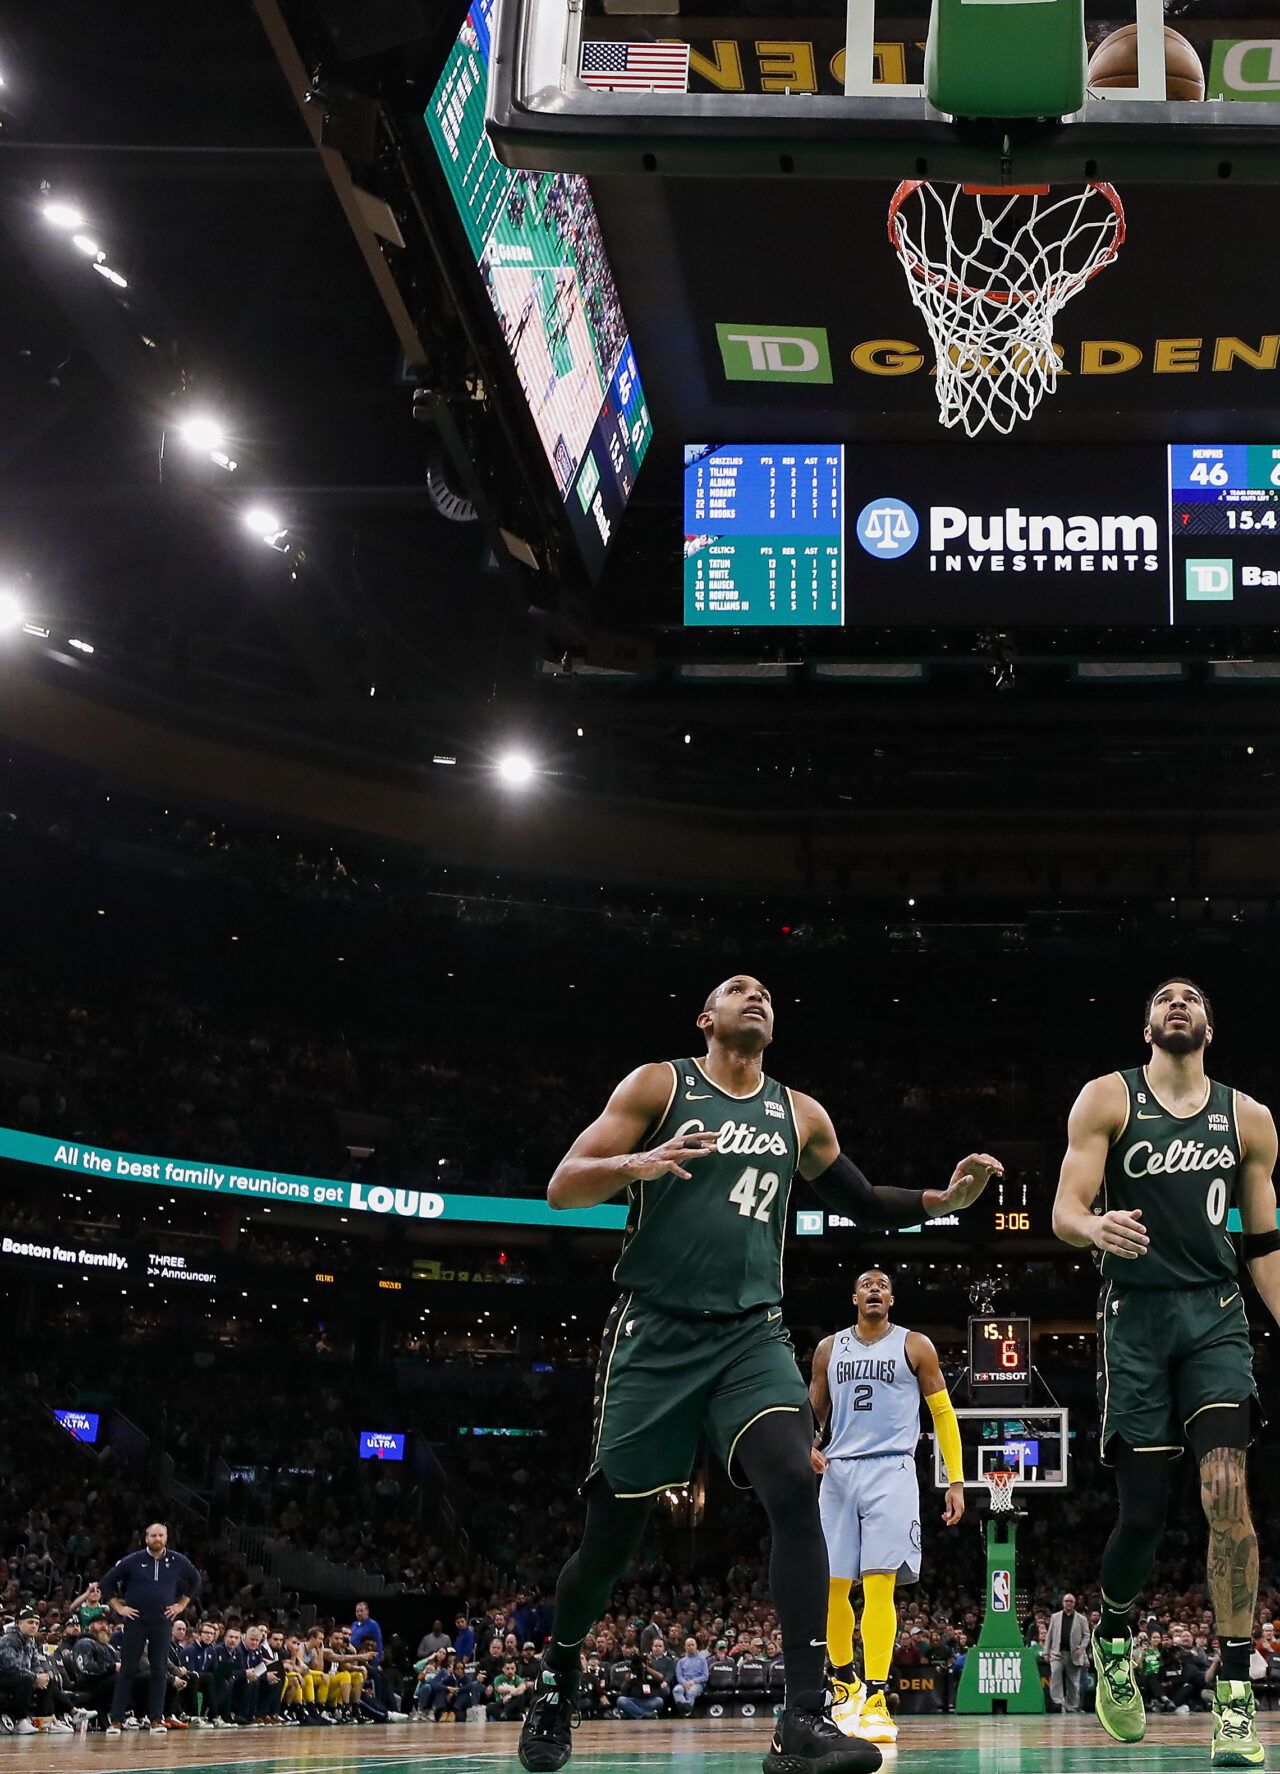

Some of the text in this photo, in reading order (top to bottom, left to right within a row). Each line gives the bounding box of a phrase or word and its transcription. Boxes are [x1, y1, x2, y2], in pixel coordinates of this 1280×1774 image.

[728, 335, 820, 372] TD
[709, 457, 743, 465] GRIZZLIES
[1193, 449, 1223, 458] MEMPHIS
[1190, 463, 1228, 485] 46
[697, 489, 704, 498] 12
[696, 499, 705, 508] 22
[1227, 511, 1276, 529] 15.4
[930, 507, 1157, 551] Putnam
[709, 546, 735, 554] CELTICS
[931, 555, 1158, 571] INVESTMENTS
[695, 581, 704, 590] 30
[1190, 566, 1229, 592] TD
[695, 591, 704, 600] 42
[695, 602, 704, 611] 44
[685, 1075, 695, 1087] 6
[1136, 1092, 1147, 1104] 6
[763, 1100, 785, 1113] VISTA
[765, 1108, 785, 1119] PRINT
[1207, 1114, 1229, 1125] VISTA
[1208, 1123, 1229, 1132] PRINT
[674, 1119, 788, 1156] Cltics
[1123, 1139, 1236, 1179] Celtics
[54, 1146, 444, 1218] All the best family reunions get LOUD
[728, 1166, 780, 1224] 42
[1206, 1177, 1227, 1226] 0
[800, 1215, 821, 1231] TD
[995, 1212, 1030, 1230] 3:06
[2, 1237, 129, 1270] Boston fan family.
[148, 1254, 187, 1268] THREE.
[983, 1323, 1013, 1340] 15.1
[1002, 1340, 1018, 1367] 6
[836, 1360, 895, 1385] GRIZZLIES
[989, 1372, 1027, 1381] TISSOT
[853, 1384, 873, 1411] 2
[367, 1439, 397, 1449] ULTRA
[979, 1658, 1022, 1679] BLACK
[979, 1679, 1022, 1694] HISTORY
